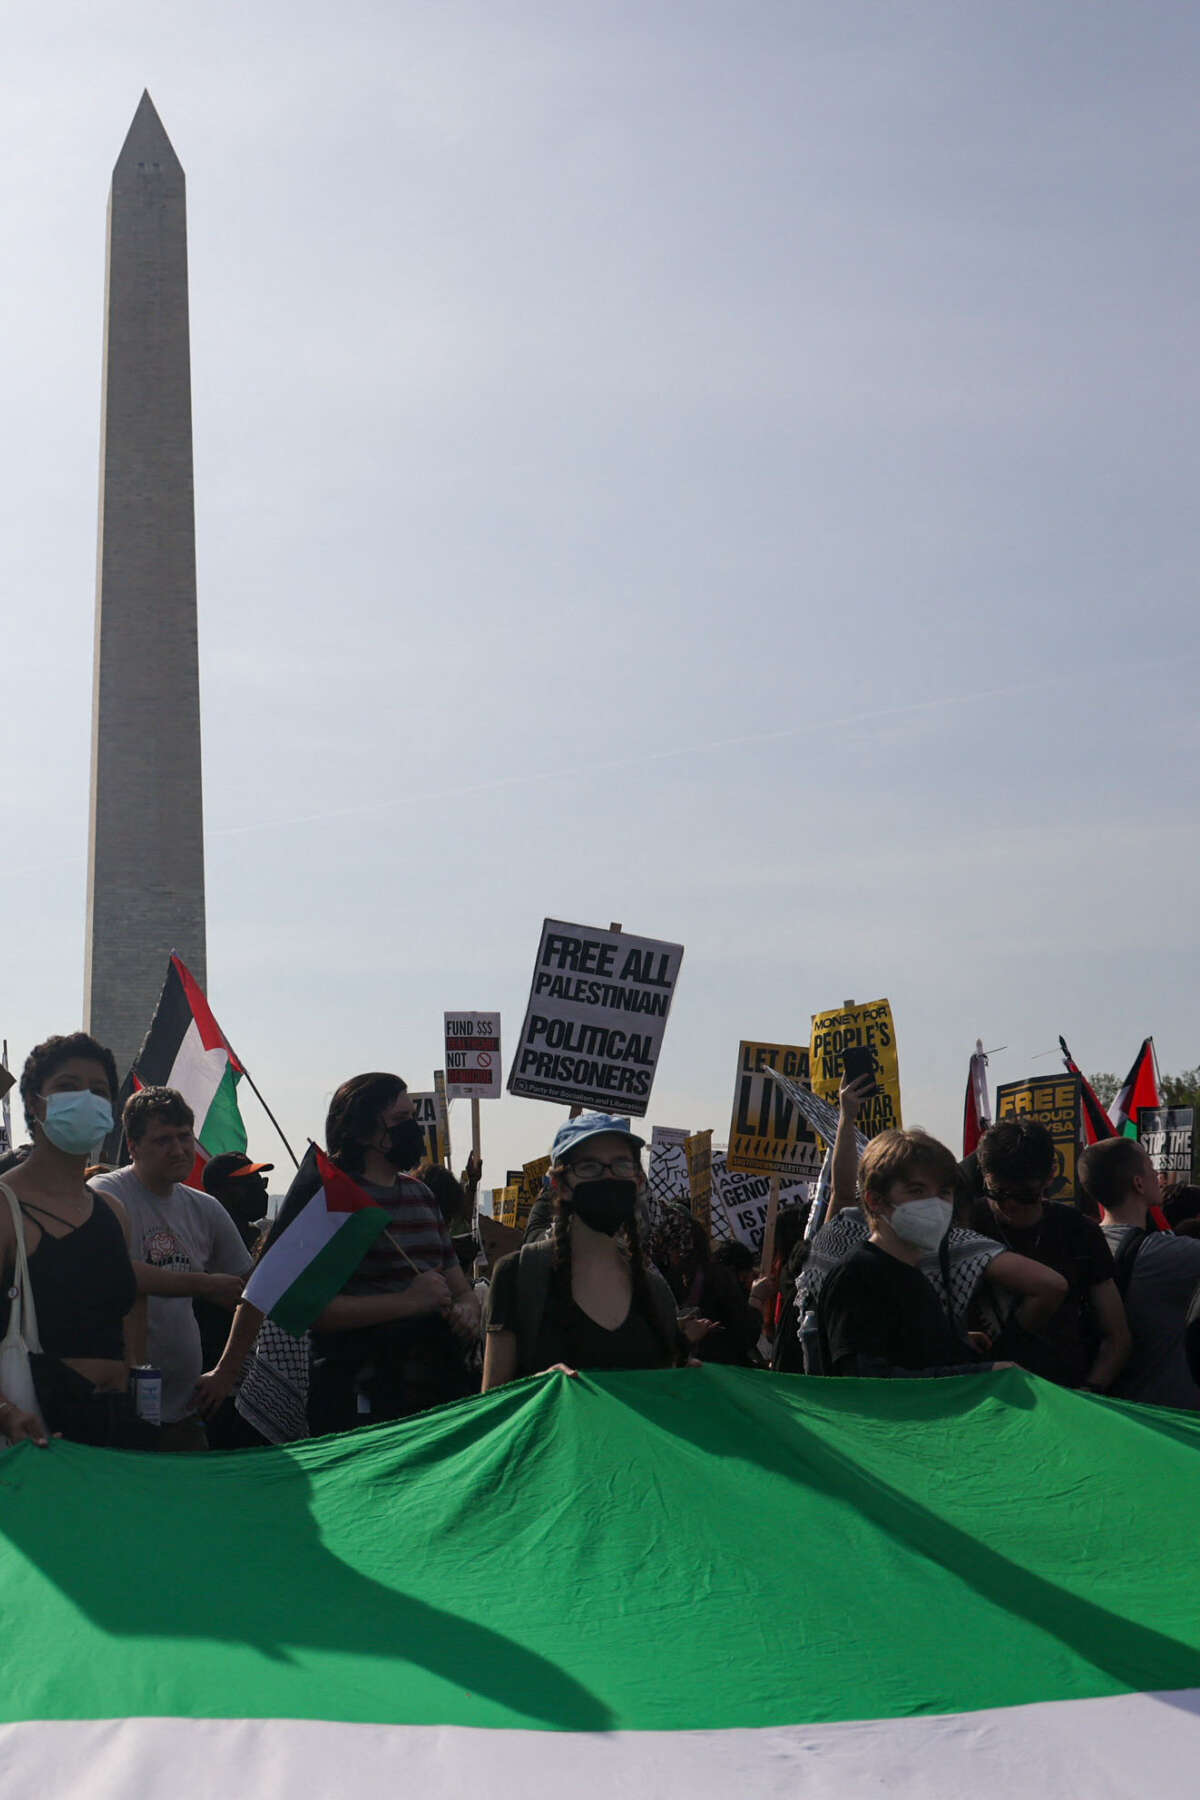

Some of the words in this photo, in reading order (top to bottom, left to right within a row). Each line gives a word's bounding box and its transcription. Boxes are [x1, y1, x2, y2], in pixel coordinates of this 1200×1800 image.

[543, 934, 618, 978] FREE
[620, 949, 672, 988] ALL
[535, 972, 669, 1017] PALESTINIAN
[447, 1021, 473, 1036] FUND
[477, 1021, 493, 1035] $$$
[814, 1012, 861, 1031] MONEY
[863, 1007, 887, 1021] FOR
[527, 1015, 654, 1065] POLITICAL
[814, 1022, 891, 1058] PEOPLE'S
[447, 1052, 467, 1068] NOT
[520, 1049, 651, 1096] PRISONERS
[743, 1046, 778, 1074] LET
[783, 1052, 809, 1079] GA
[412, 1098, 437, 1121] ZA
[1000, 1085, 1076, 1118] FREE
[1141, 1132, 1167, 1154] STOP
[1169, 1131, 1192, 1153] THE
[1151, 1154, 1192, 1171] ESSION
[737, 1209, 757, 1231] IS
